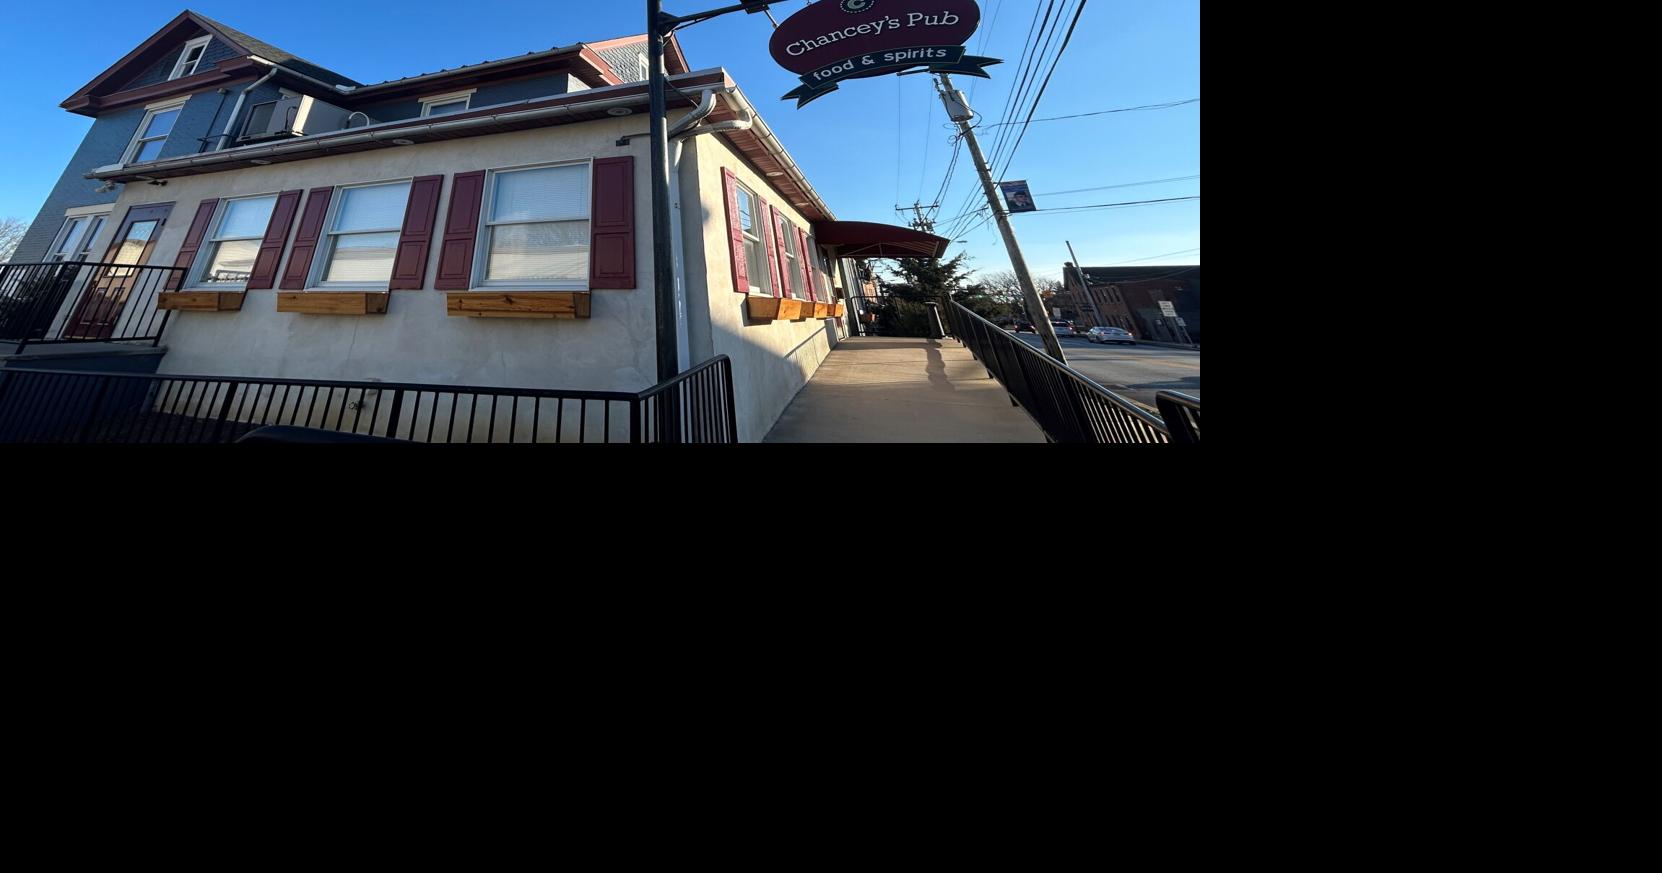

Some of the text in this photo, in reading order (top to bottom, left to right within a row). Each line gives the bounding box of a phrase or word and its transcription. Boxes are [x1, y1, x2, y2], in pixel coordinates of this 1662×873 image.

[786, 11, 959, 56] Chancey's Pub
[813, 47, 947, 81] food & spirits
